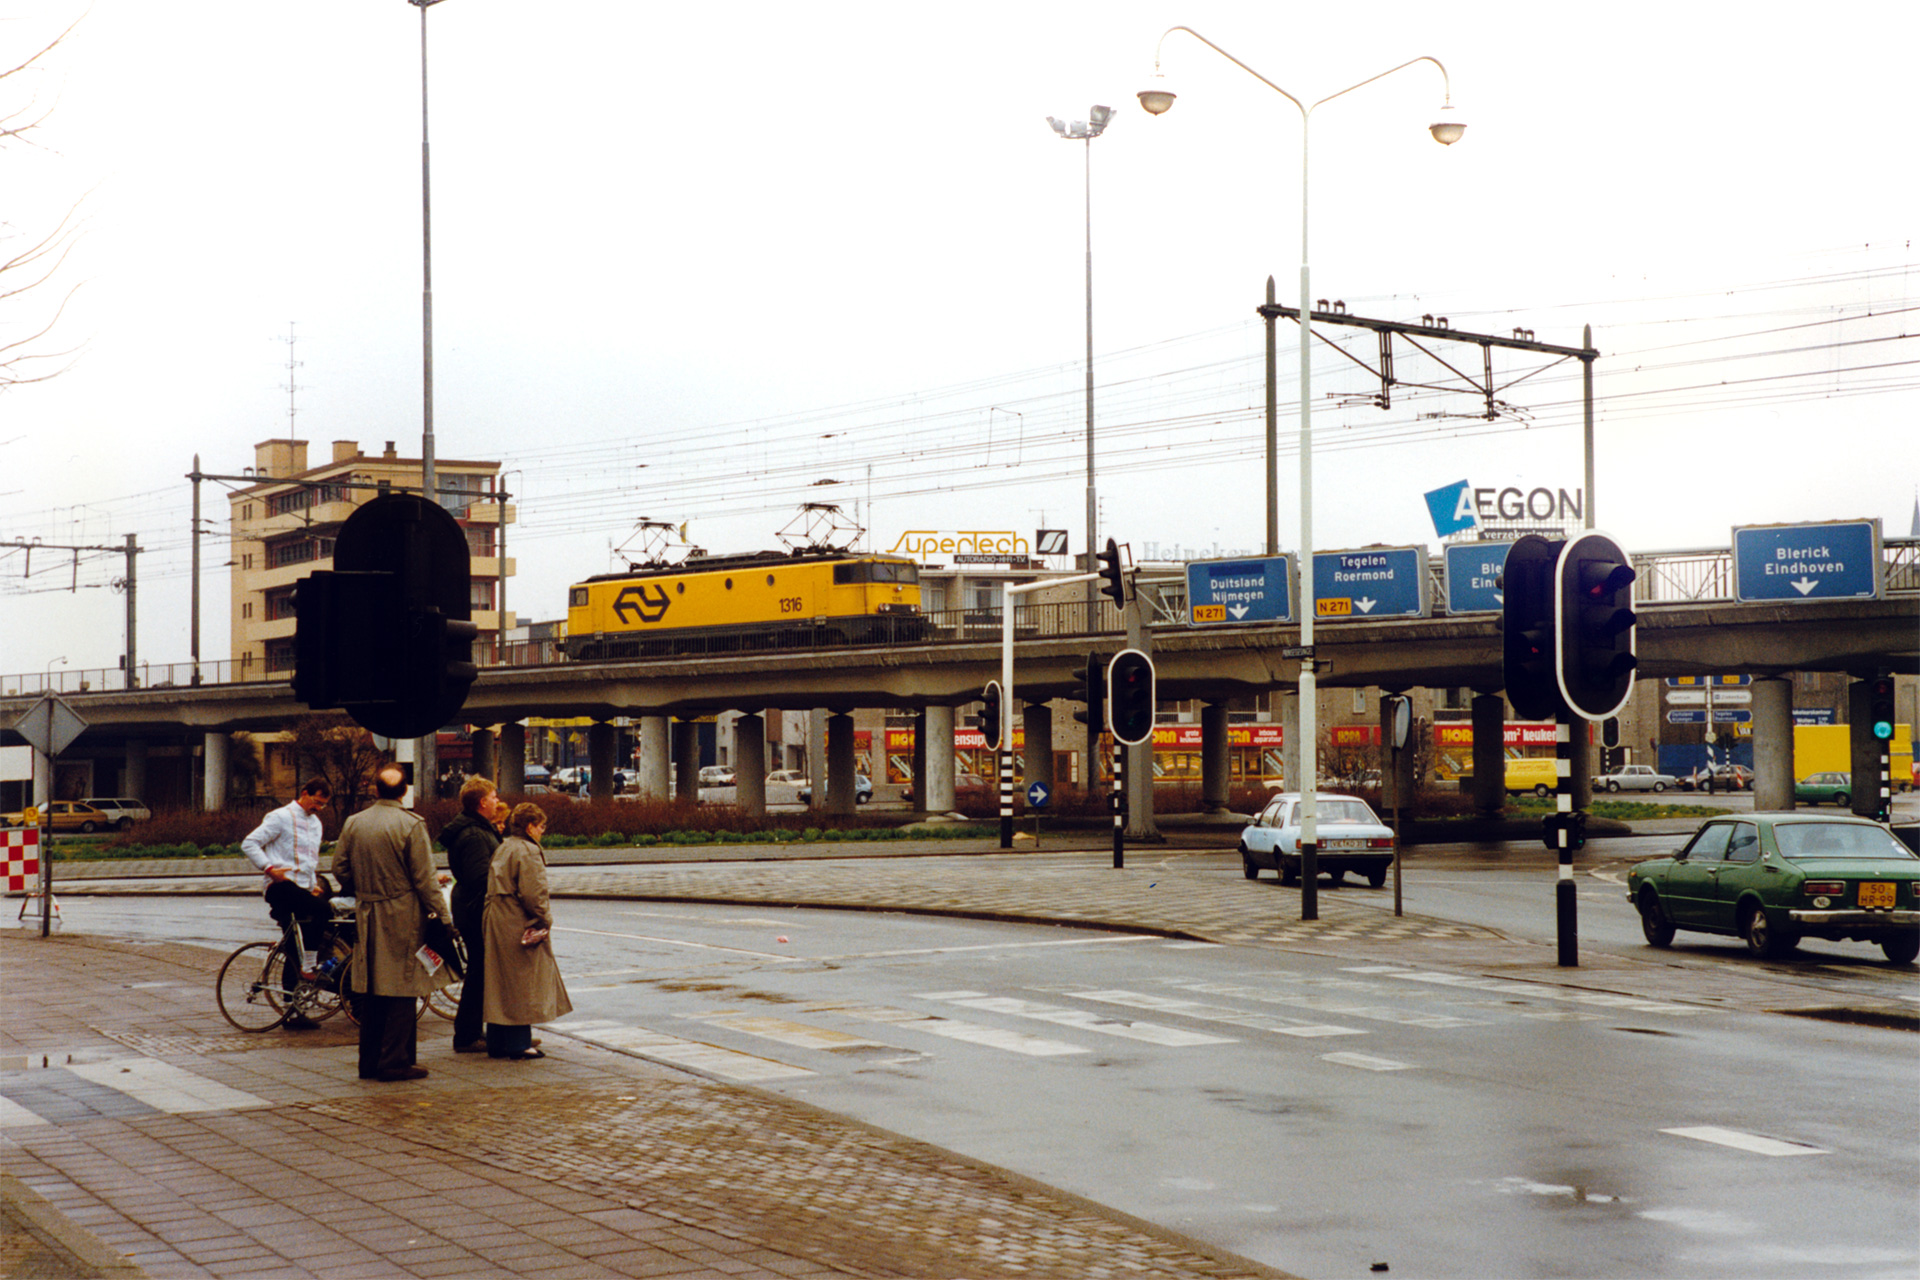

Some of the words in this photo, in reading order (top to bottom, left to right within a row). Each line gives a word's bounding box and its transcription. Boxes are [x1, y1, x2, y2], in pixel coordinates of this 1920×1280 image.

[1453, 487, 1582, 532] AEGON
[1143, 541, 1252, 560] Heineken
[1340, 556, 1387, 569] Tegelen
[1765, 562, 1844, 575] Eindhoven
[1334, 569, 1394, 582] Roermond
[1210, 576, 1265, 590] Duitsland
[1212, 590, 1264, 603] Nijmegen
[779, 597, 803, 613] 1316
[1330, 601, 1350, 612] 271
[1206, 607, 1224, 618] 271
[1870, 884, 1885, 894] 50
